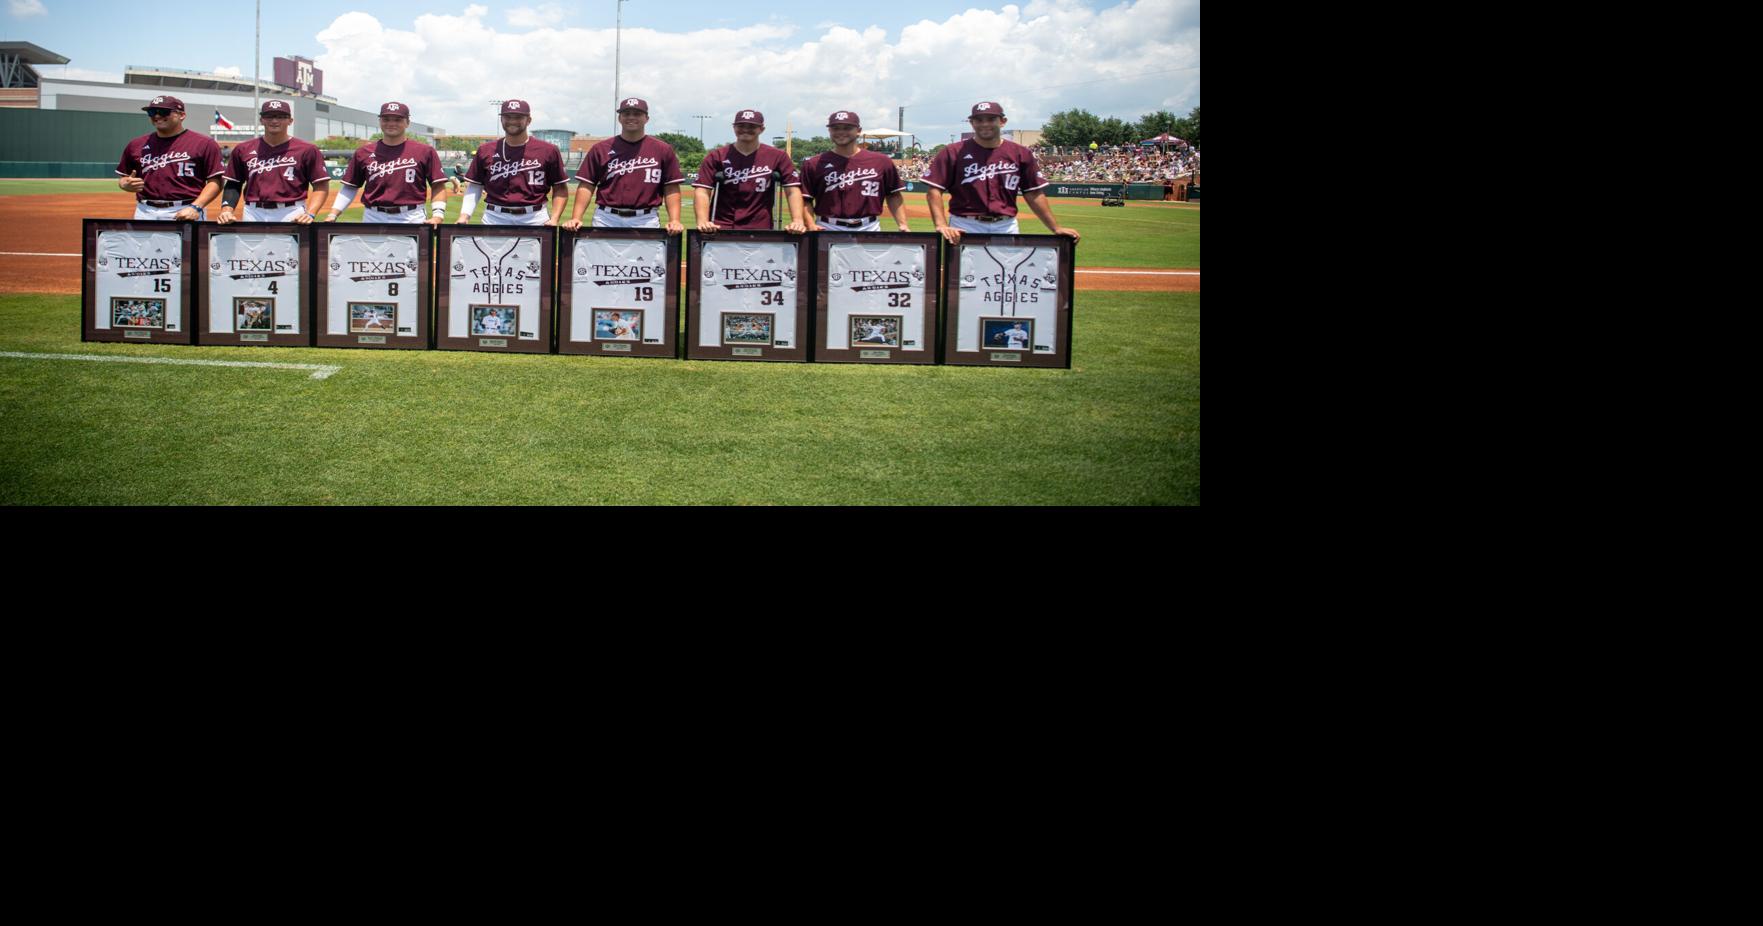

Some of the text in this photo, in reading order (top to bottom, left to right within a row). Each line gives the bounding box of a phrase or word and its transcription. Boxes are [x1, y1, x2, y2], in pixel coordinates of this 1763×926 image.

[140, 151, 189, 170] Aggies
[247, 156, 296, 173] Aggies
[367, 158, 416, 177] Aggies
[608, 157, 657, 175] Aggies
[177, 162, 196, 177] 15
[283, 166, 295, 181] 4
[405, 168, 416, 183] 8
[490, 159, 540, 178] Aggies
[644, 168, 662, 183] 19
[528, 170, 545, 185] 12
[755, 177, 771, 192] 3
[824, 168, 877, 188] Aggies
[861, 180, 880, 197] 32
[115, 257, 170, 269] TEXAS
[227, 259, 285, 272] TEXAS
[348, 261, 406, 273] TEXAS
[469, 266, 525, 280] TEXAS
[592, 264, 651, 278] TEXAS
[722, 268, 782, 281] TEXAS
[849, 270, 910, 283] TEXAS
[154, 278, 171, 293] 15
[267, 280, 278, 295] 4
[473, 282, 523, 294] AGGIES
[980, 273, 1042, 289] TEXAS
[388, 282, 399, 296] 8
[634, 286, 653, 302] 19
[760, 290, 785, 306] 34
[888, 292, 911, 308] 32
[984, 291, 1038, 303] AGGIES
